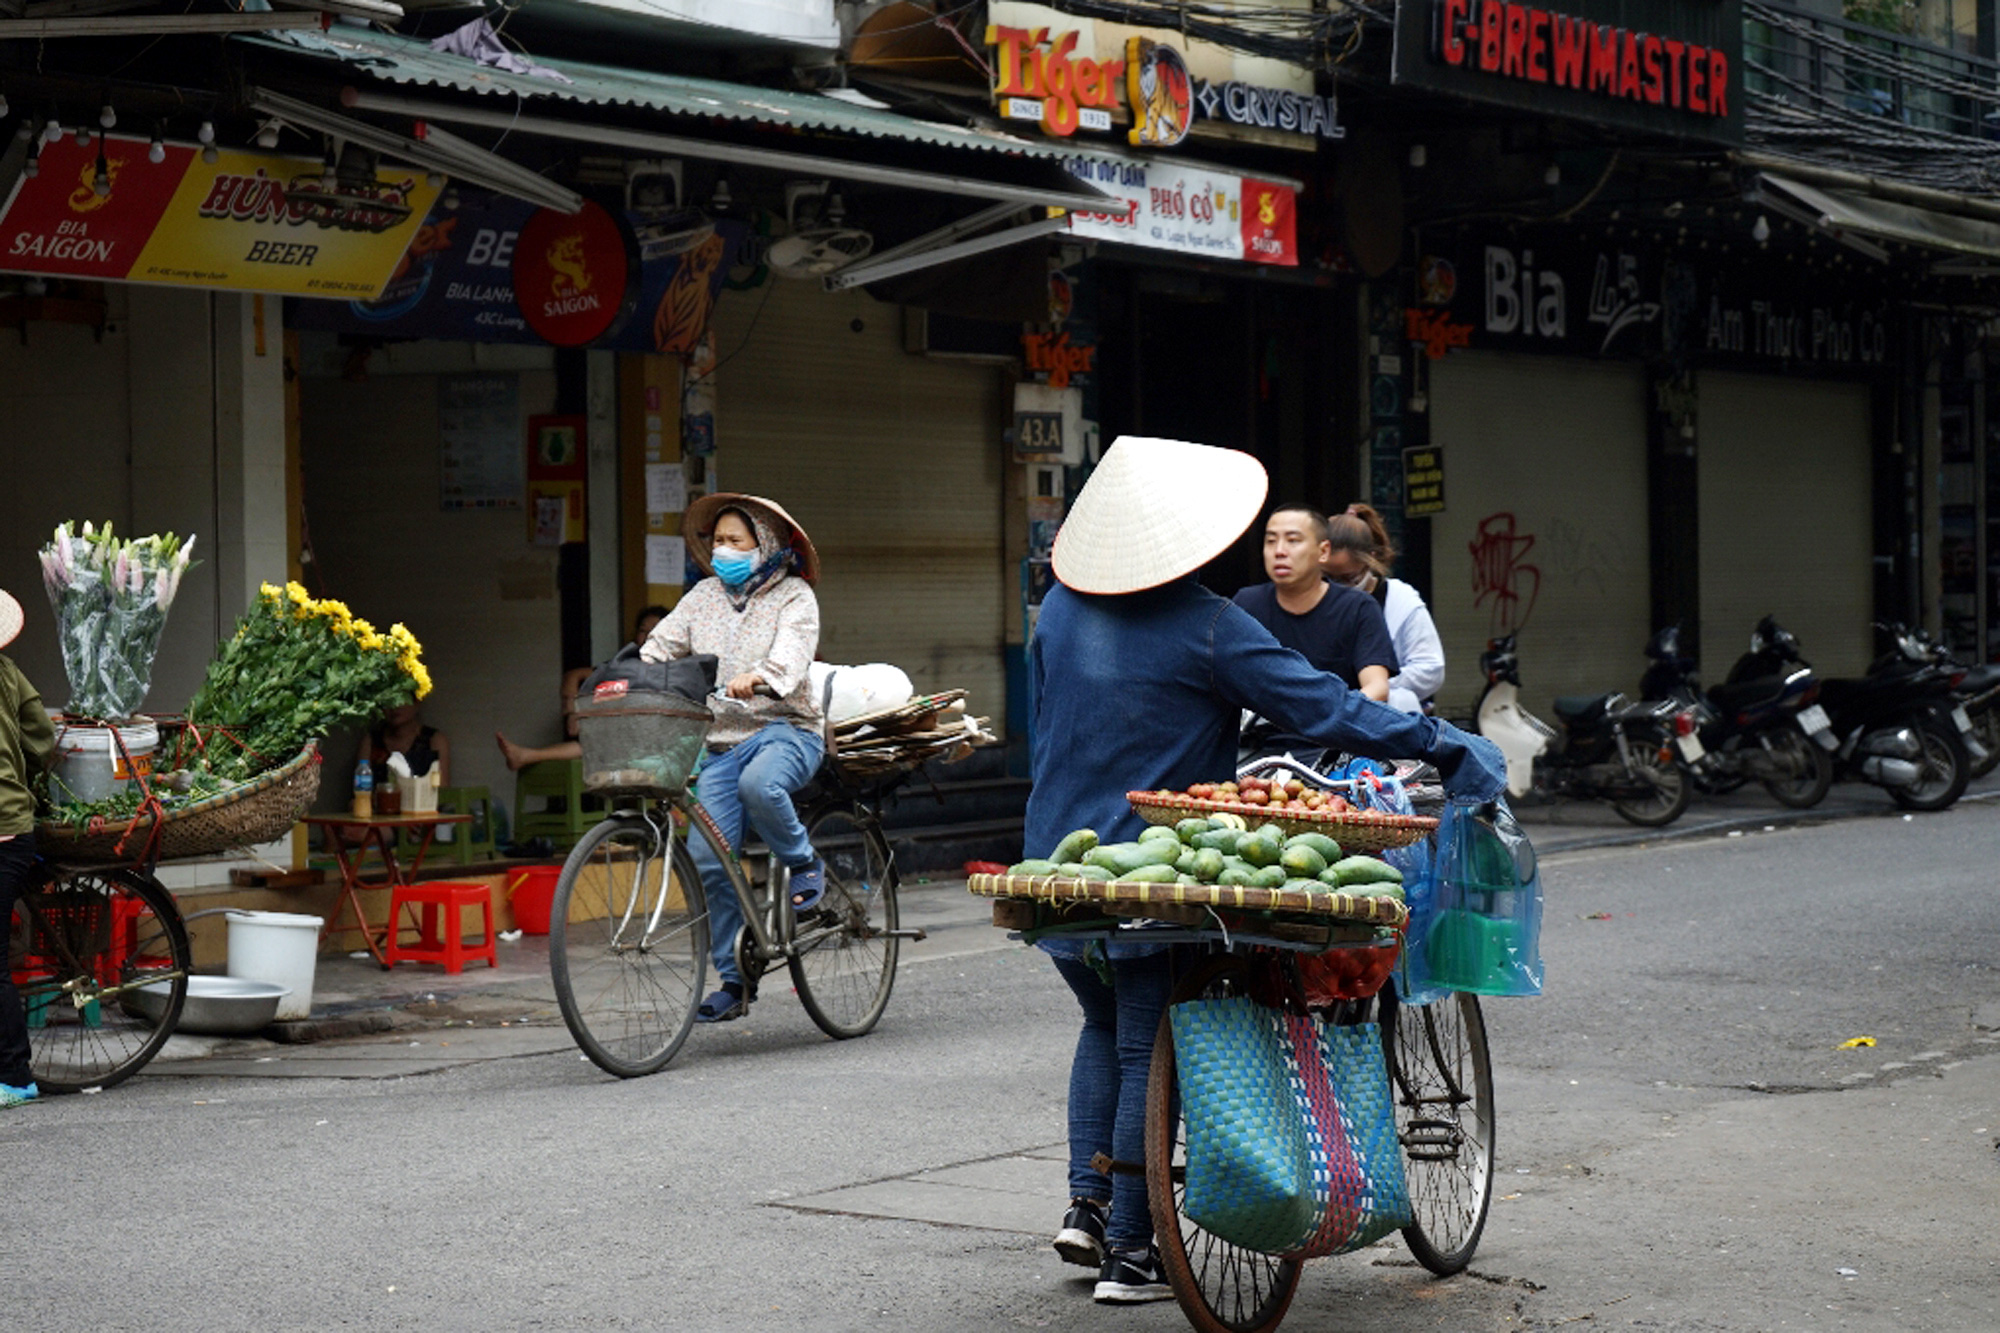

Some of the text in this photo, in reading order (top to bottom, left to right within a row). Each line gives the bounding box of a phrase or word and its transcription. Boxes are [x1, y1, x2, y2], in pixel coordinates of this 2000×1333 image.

[1443, 0, 1728, 117] C-BREWMASTER
[985, 24, 1125, 136] Tiger
[1011, 101, 1042, 119] SINCE
[1082, 111, 1108, 128] 1932
[1224, 80, 1346, 139] CRYSTAL
[57, 219, 88, 238] BIA
[9, 232, 114, 262] SAIGON
[245, 240, 319, 267] BEER
[445, 282, 471, 300] BIA
[1484, 244, 1568, 339] Bia
[543, 293, 600, 318] SAIGON
[1019, 331, 1097, 389] Tiger
